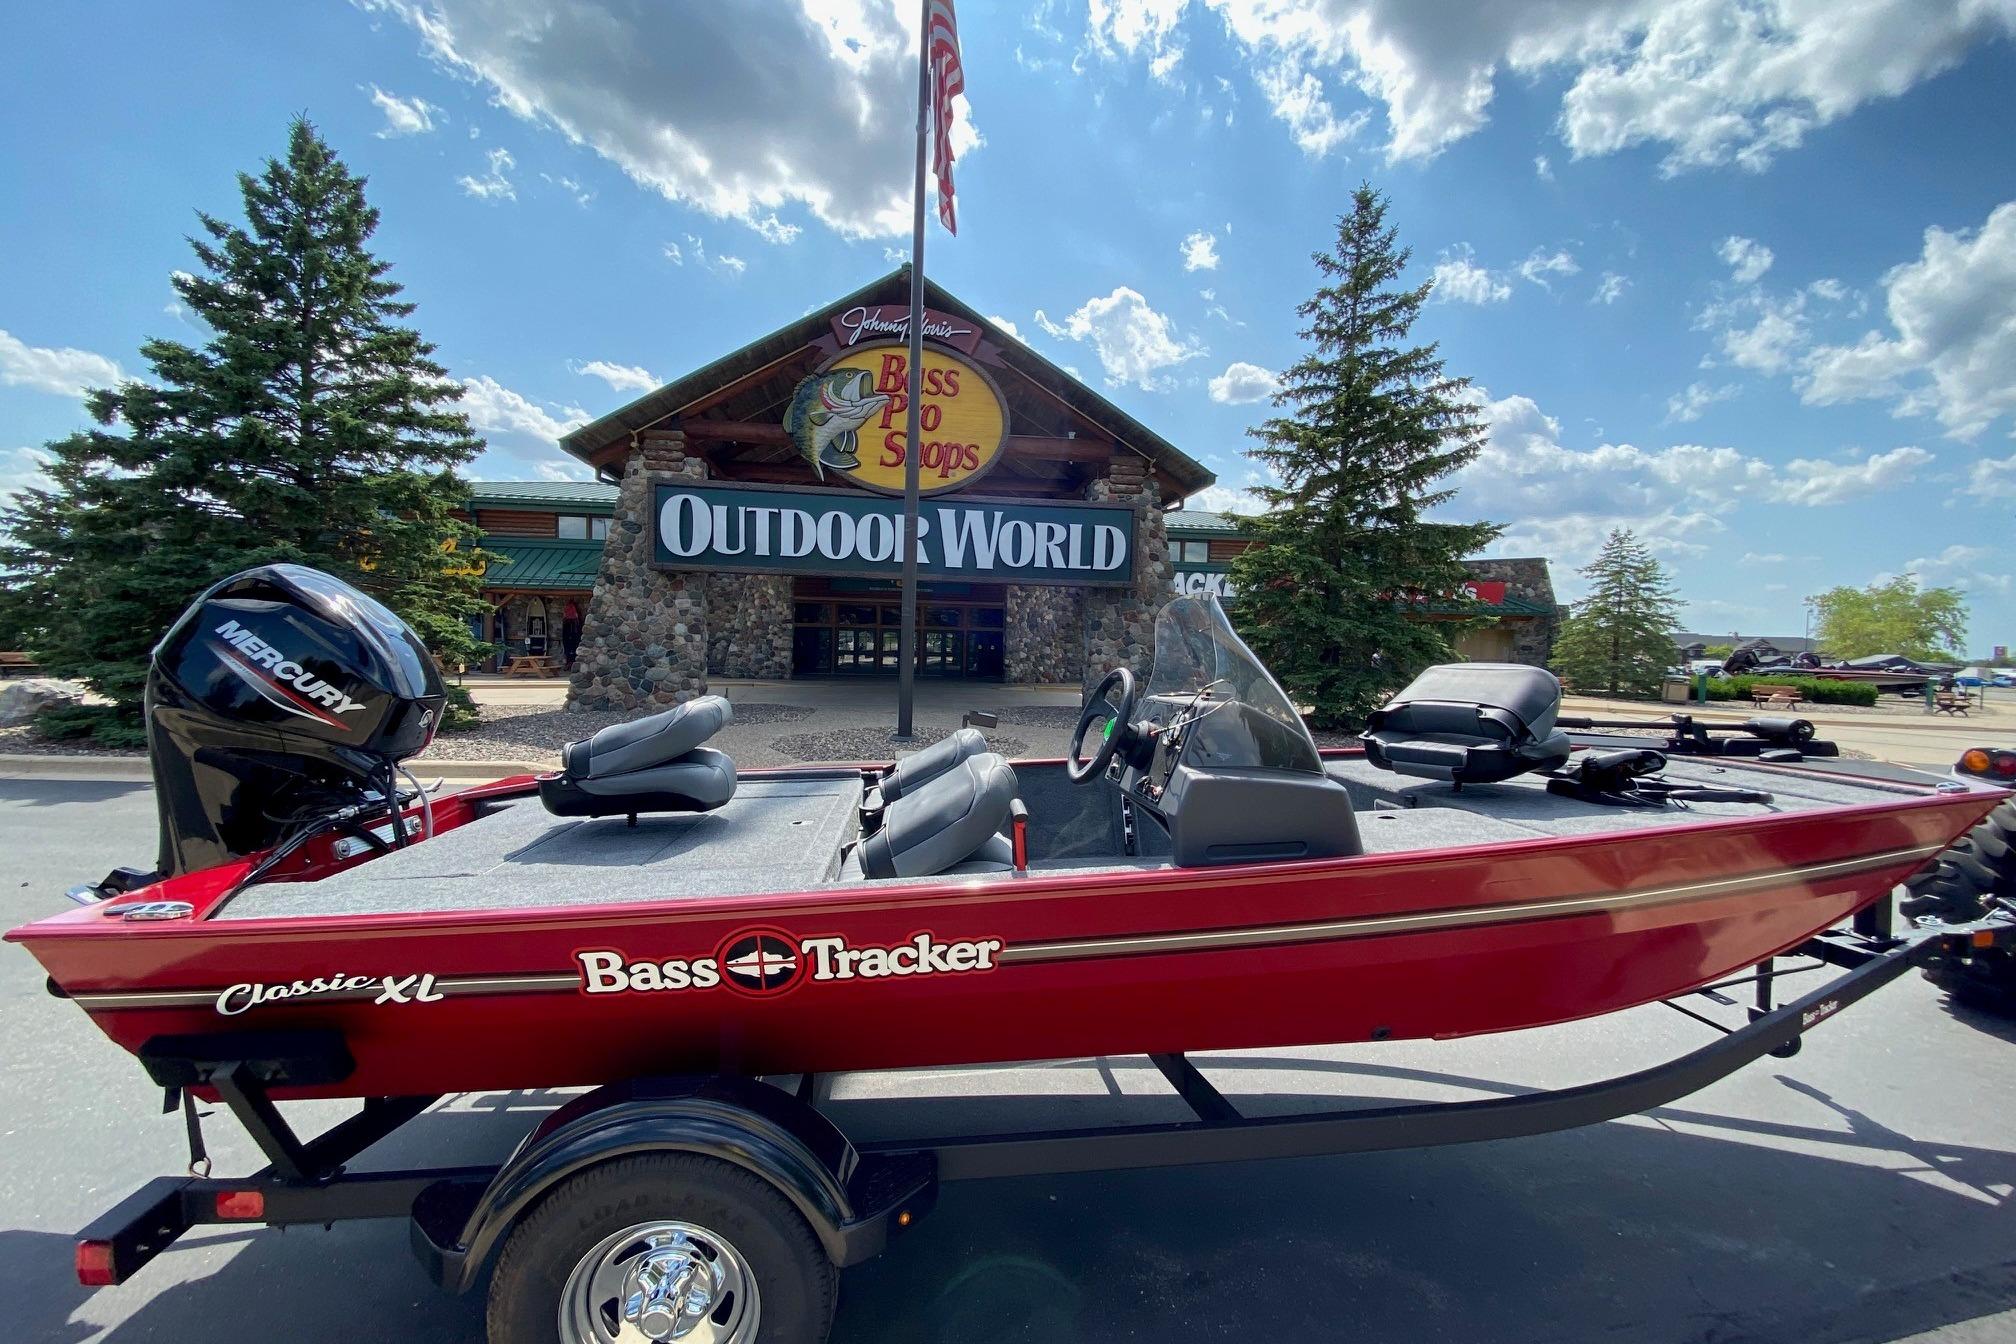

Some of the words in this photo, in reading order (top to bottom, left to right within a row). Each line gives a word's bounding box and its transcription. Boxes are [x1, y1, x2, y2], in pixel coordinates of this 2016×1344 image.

[841, 306, 911, 345] Johnny
[909, 305, 972, 338] orris
[878, 393, 942, 432] Po
[659, 493, 931, 565] OUTDOOR
[937, 508, 1127, 572] WORLD
[214, 619, 366, 715] MERCURY
[578, 951, 720, 993] Bass
[802, 934, 1000, 980] Tracker
[215, 972, 377, 1016] Classic
[374, 973, 444, 1005] XL
